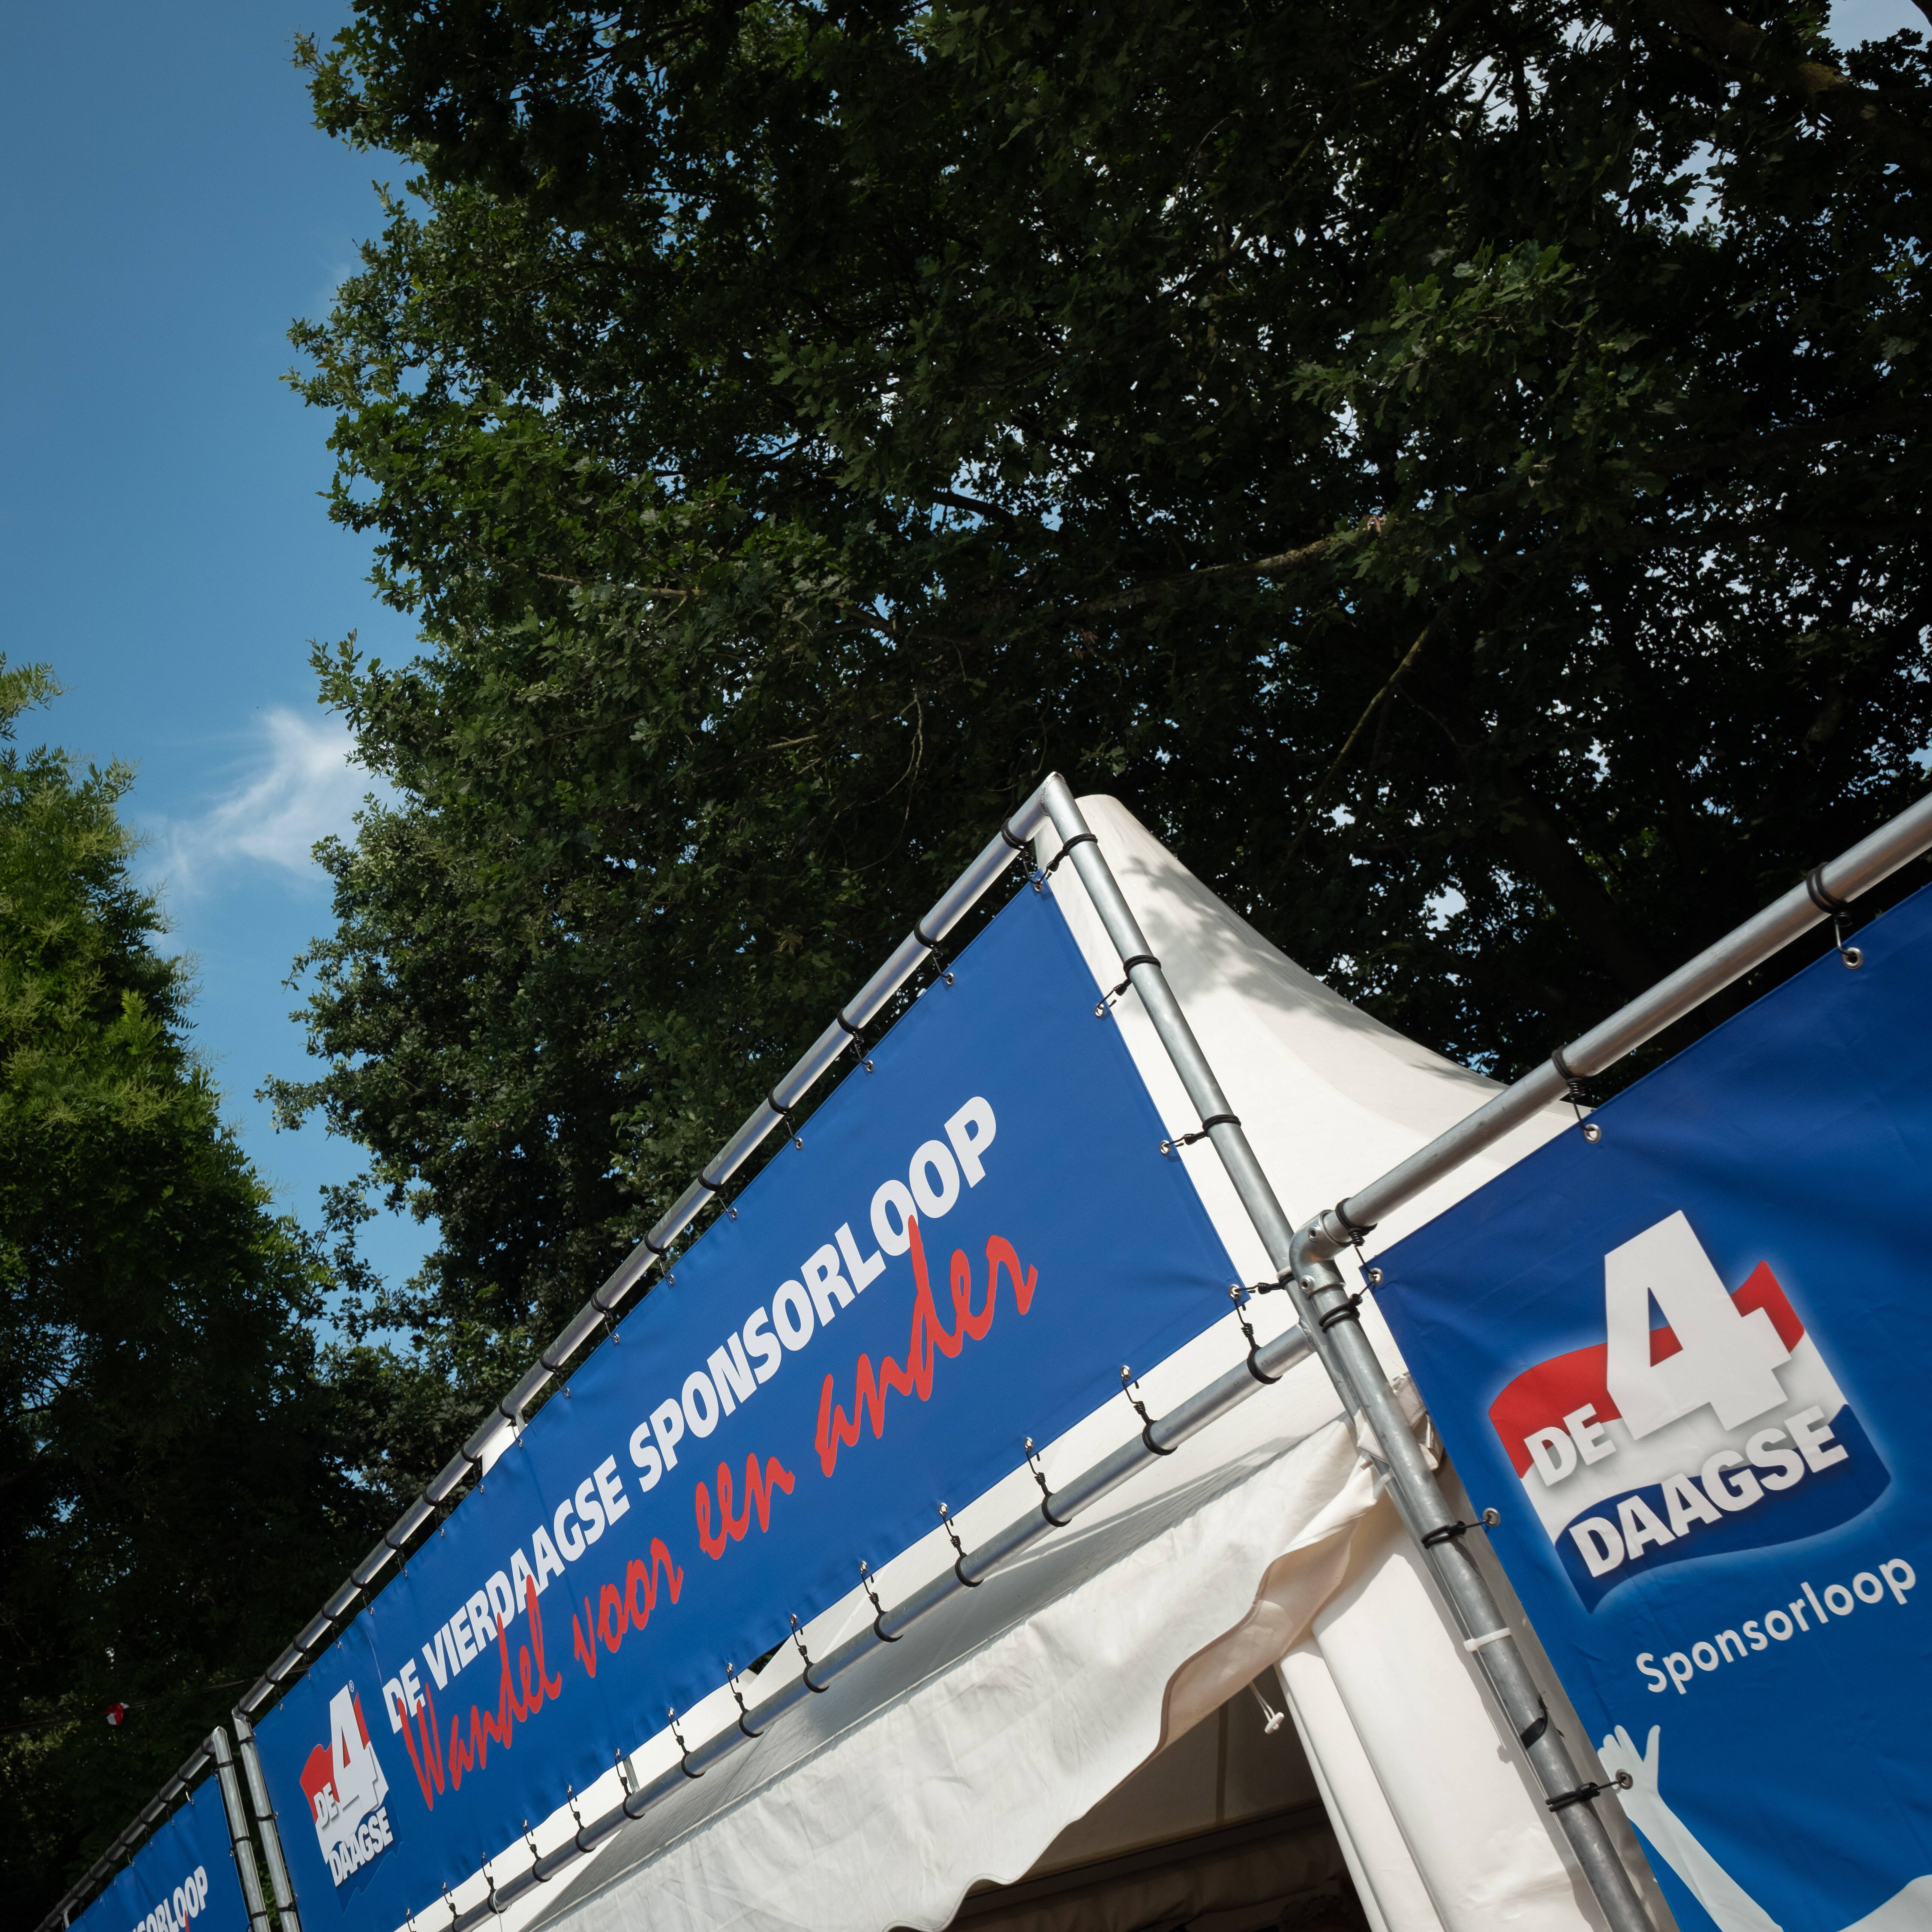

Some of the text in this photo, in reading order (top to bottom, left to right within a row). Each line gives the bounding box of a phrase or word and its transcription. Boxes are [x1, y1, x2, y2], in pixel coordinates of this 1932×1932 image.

[1605, 1210, 1792, 1441] 4
[382, 1096, 997, 1734] DE VIERDAAGSE SPONSORLOOP
[1523, 1402, 1617, 1487] DE
[397, 1215, 1038, 1811] Wandel voor een ander
[1569, 1404, 1849, 1578] DAAGSE
[1635, 1558, 1917, 1695] Sponsorloop
[313, 1782, 338, 1827] DE
[329, 1684, 378, 1812] 4
[328, 1806, 393, 1887] DAAGSE
